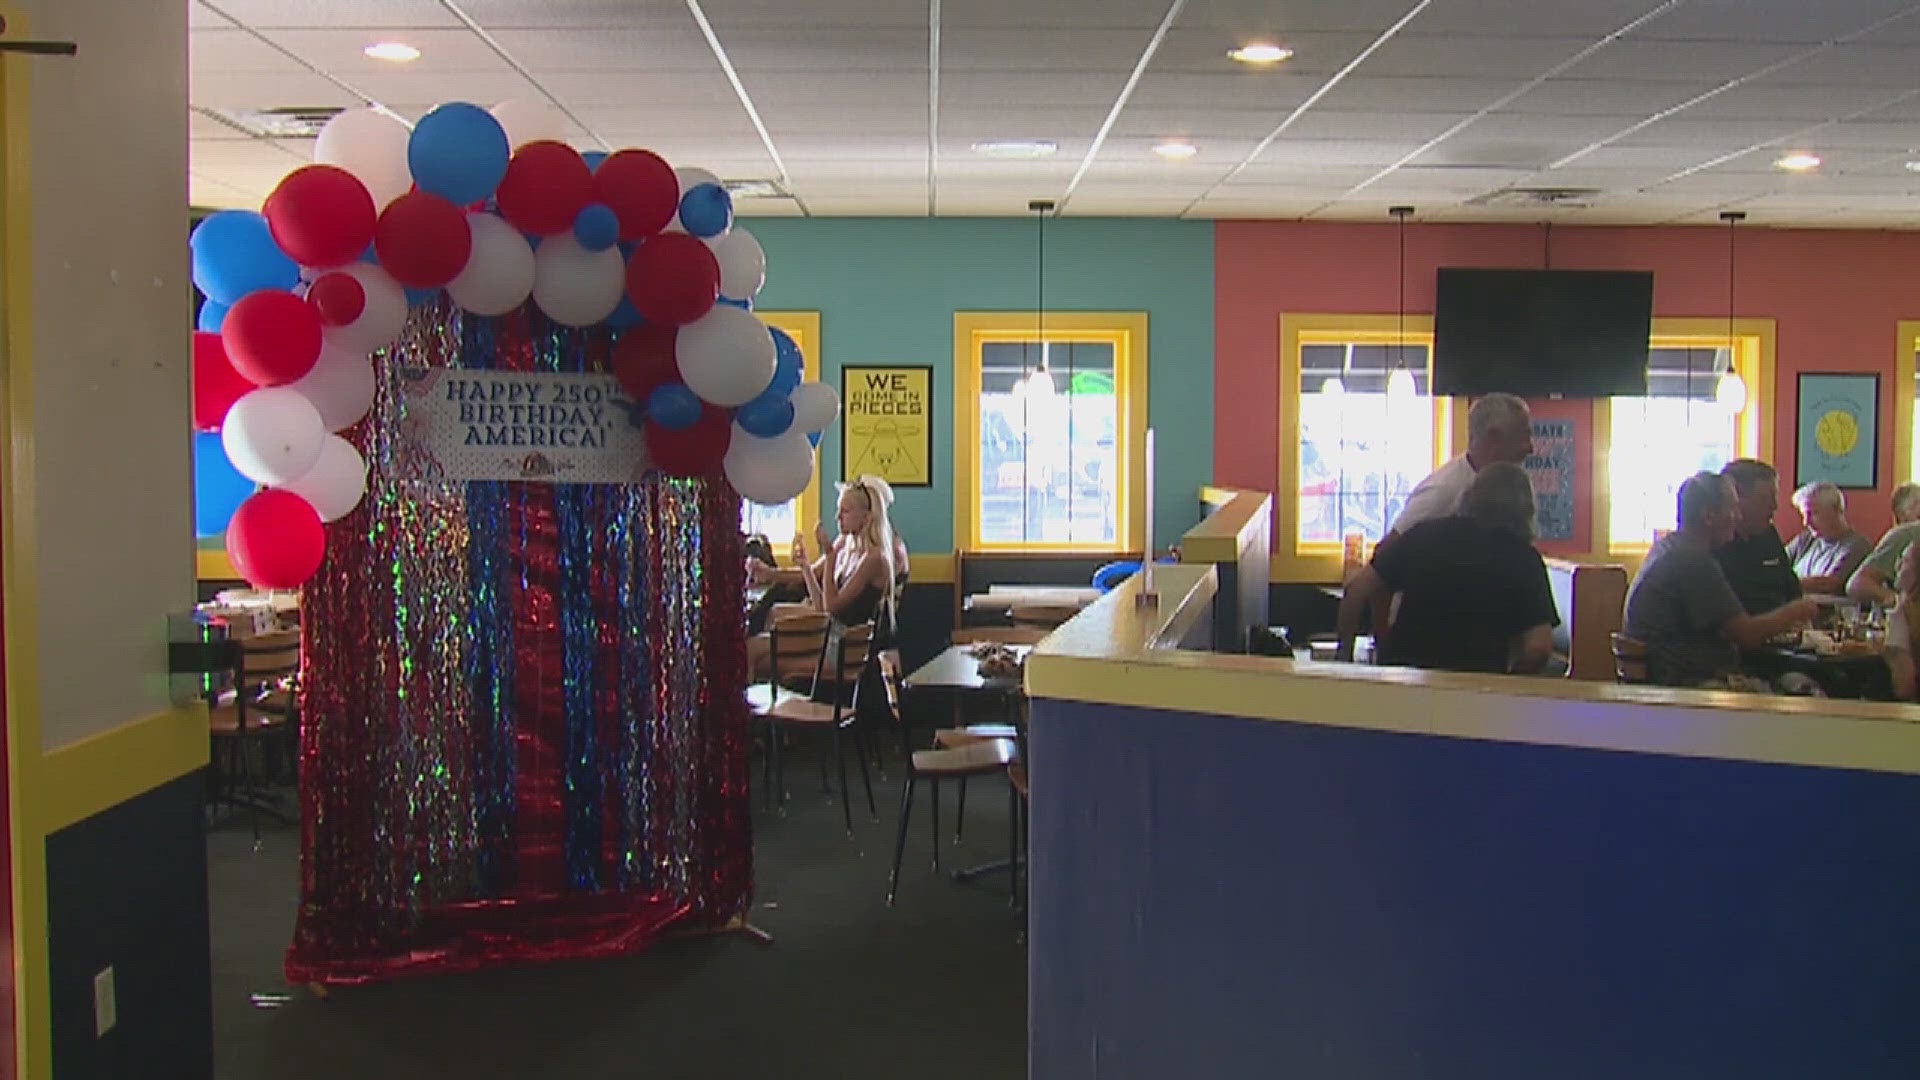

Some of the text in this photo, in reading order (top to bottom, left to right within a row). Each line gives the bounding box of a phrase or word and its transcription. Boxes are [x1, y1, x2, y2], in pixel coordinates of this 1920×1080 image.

[446, 380, 542, 403] HAPPY
[865, 373, 907, 391] WE
[852, 391, 920, 401] COME IN
[458, 404, 614, 429] BIRTHDAY,
[850, 401, 922, 415] PIECES
[464, 425, 606, 448] AMERICA!
